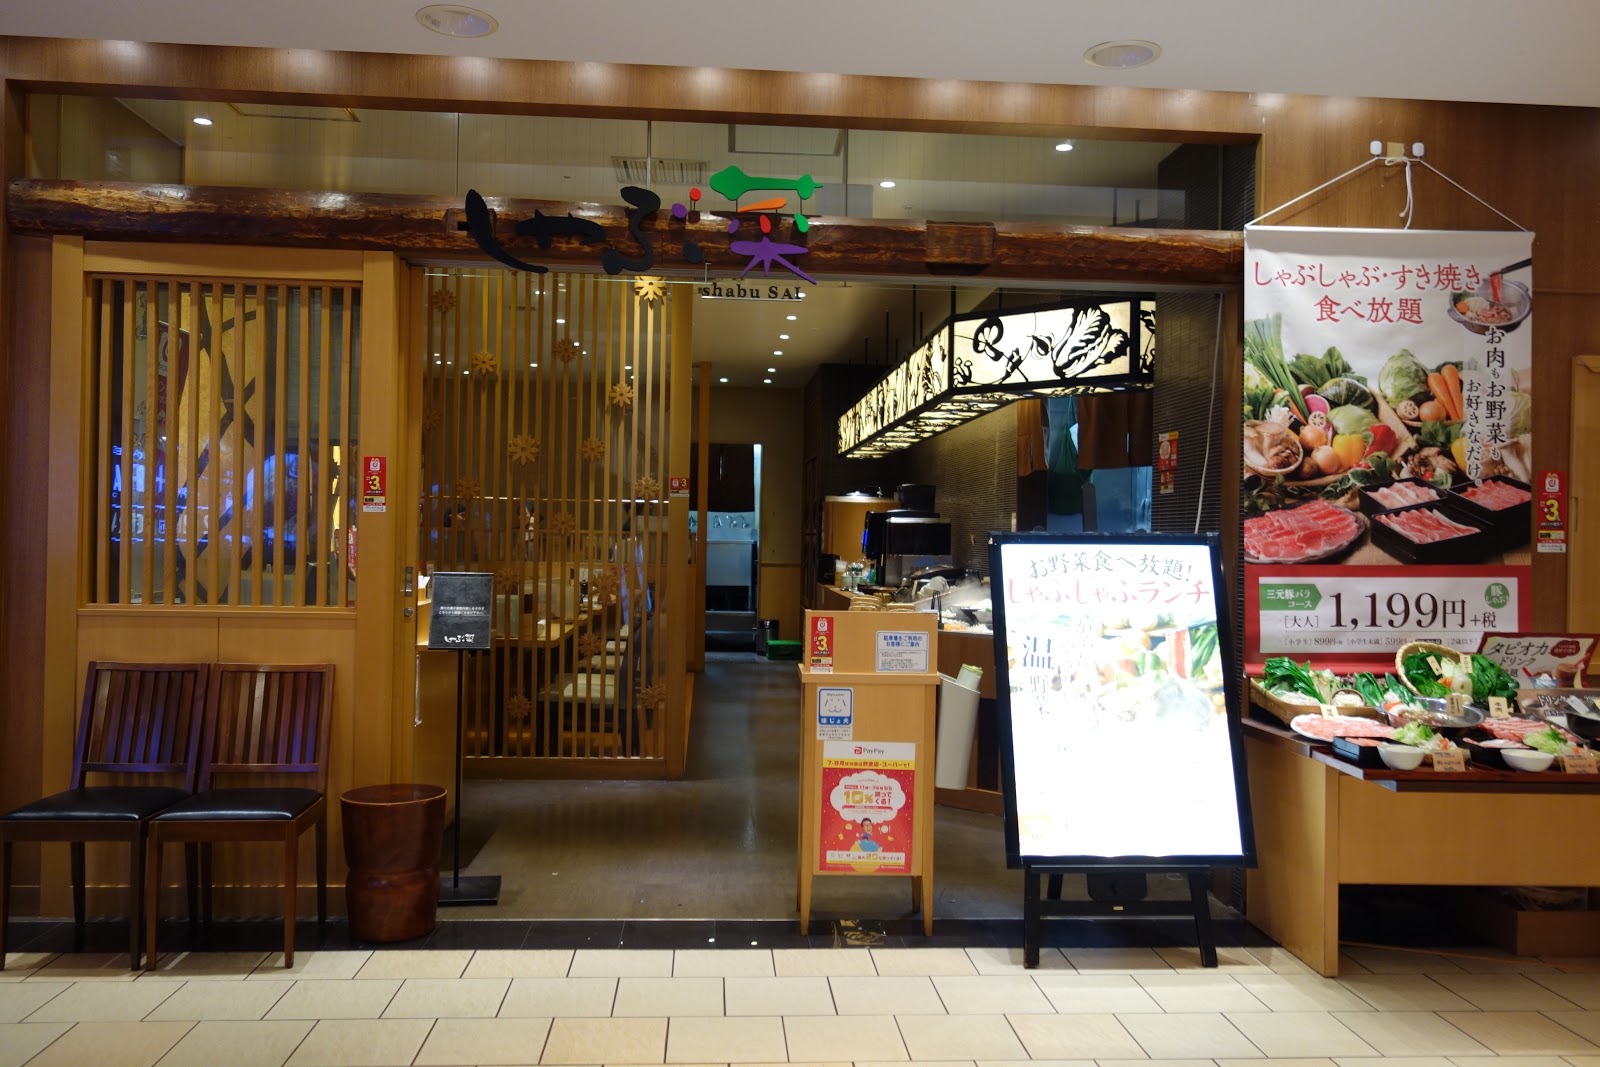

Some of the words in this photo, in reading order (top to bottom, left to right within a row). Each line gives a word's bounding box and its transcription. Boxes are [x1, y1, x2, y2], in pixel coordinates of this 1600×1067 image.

[702, 282, 760, 298] shabu
[1313, 295, 1424, 325] 食べ放題
[1484, 327, 1507, 458] お肉もお野菜も
[1287, 600, 1312, 609] コース
[1487, 641, 1550, 656] タピオカ
[1500, 656, 1536, 667] ドリンク
